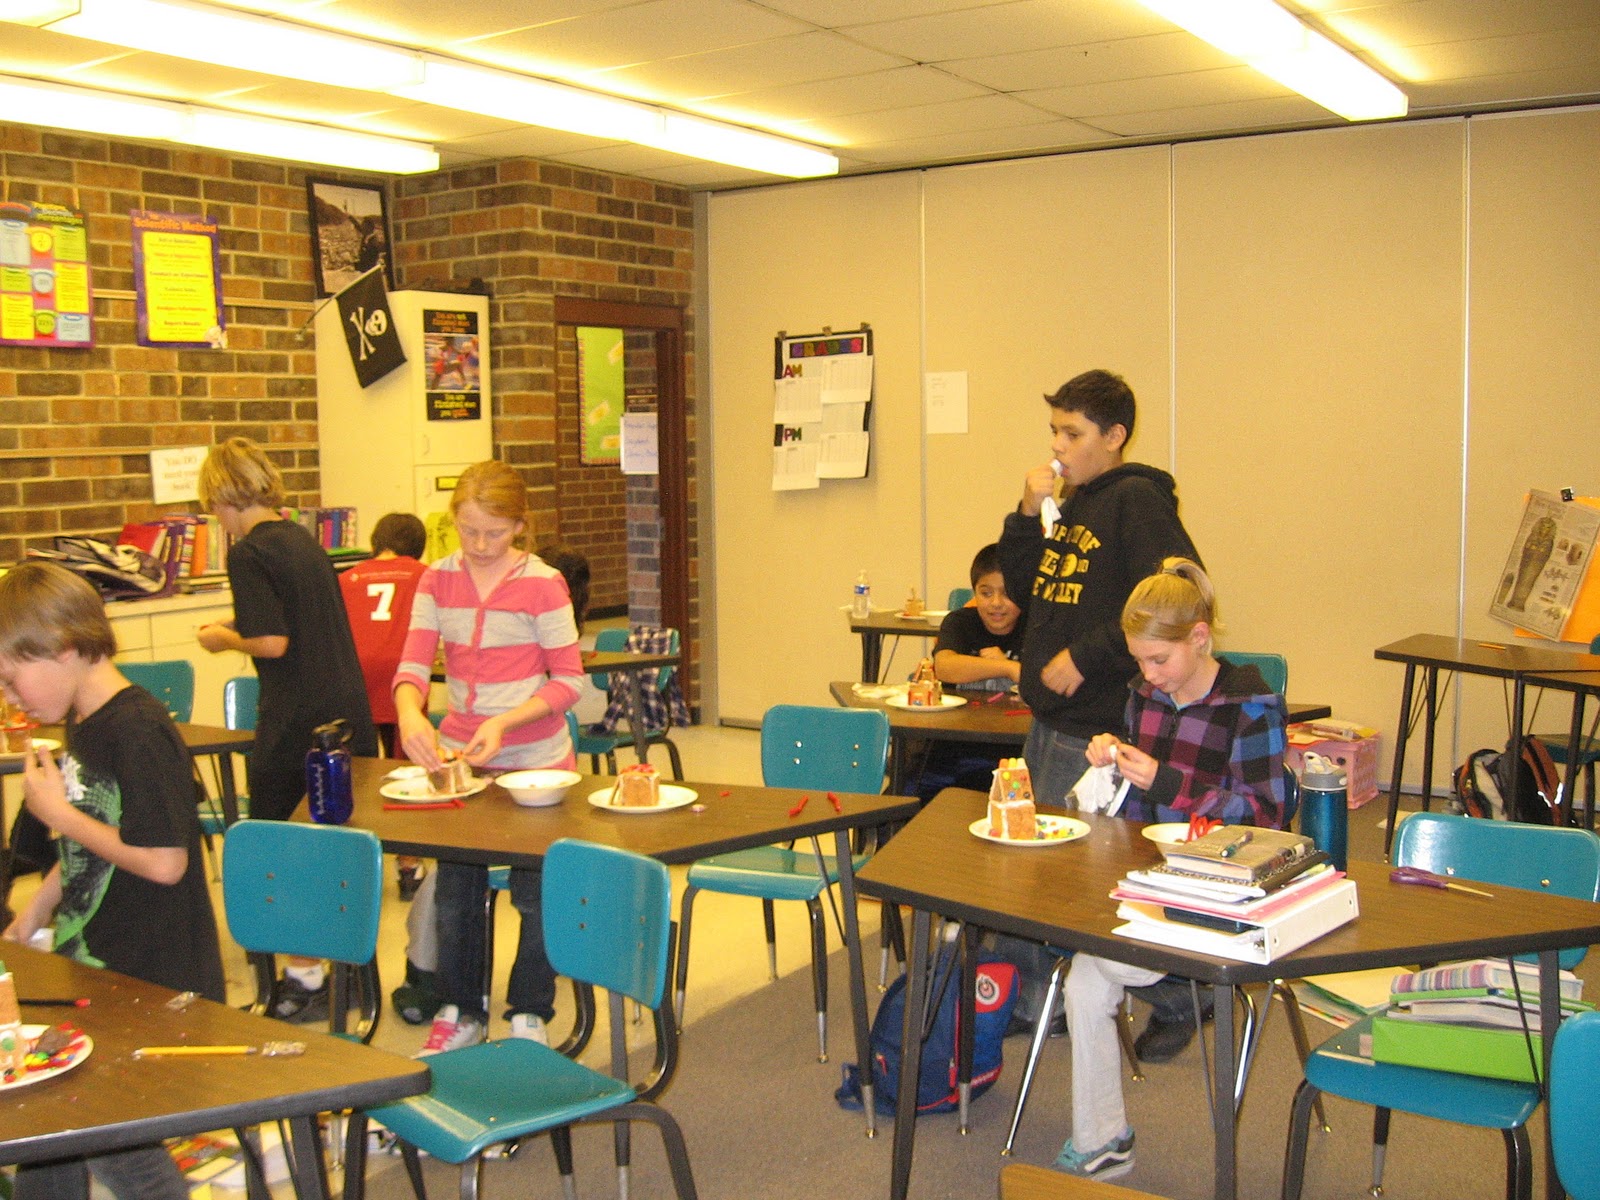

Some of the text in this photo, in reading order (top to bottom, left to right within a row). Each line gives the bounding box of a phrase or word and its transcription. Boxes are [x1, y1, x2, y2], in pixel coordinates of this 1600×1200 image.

[783, 363, 803, 378] AM
[783, 426, 803, 442] PM
[366, 582, 396, 622] 7
